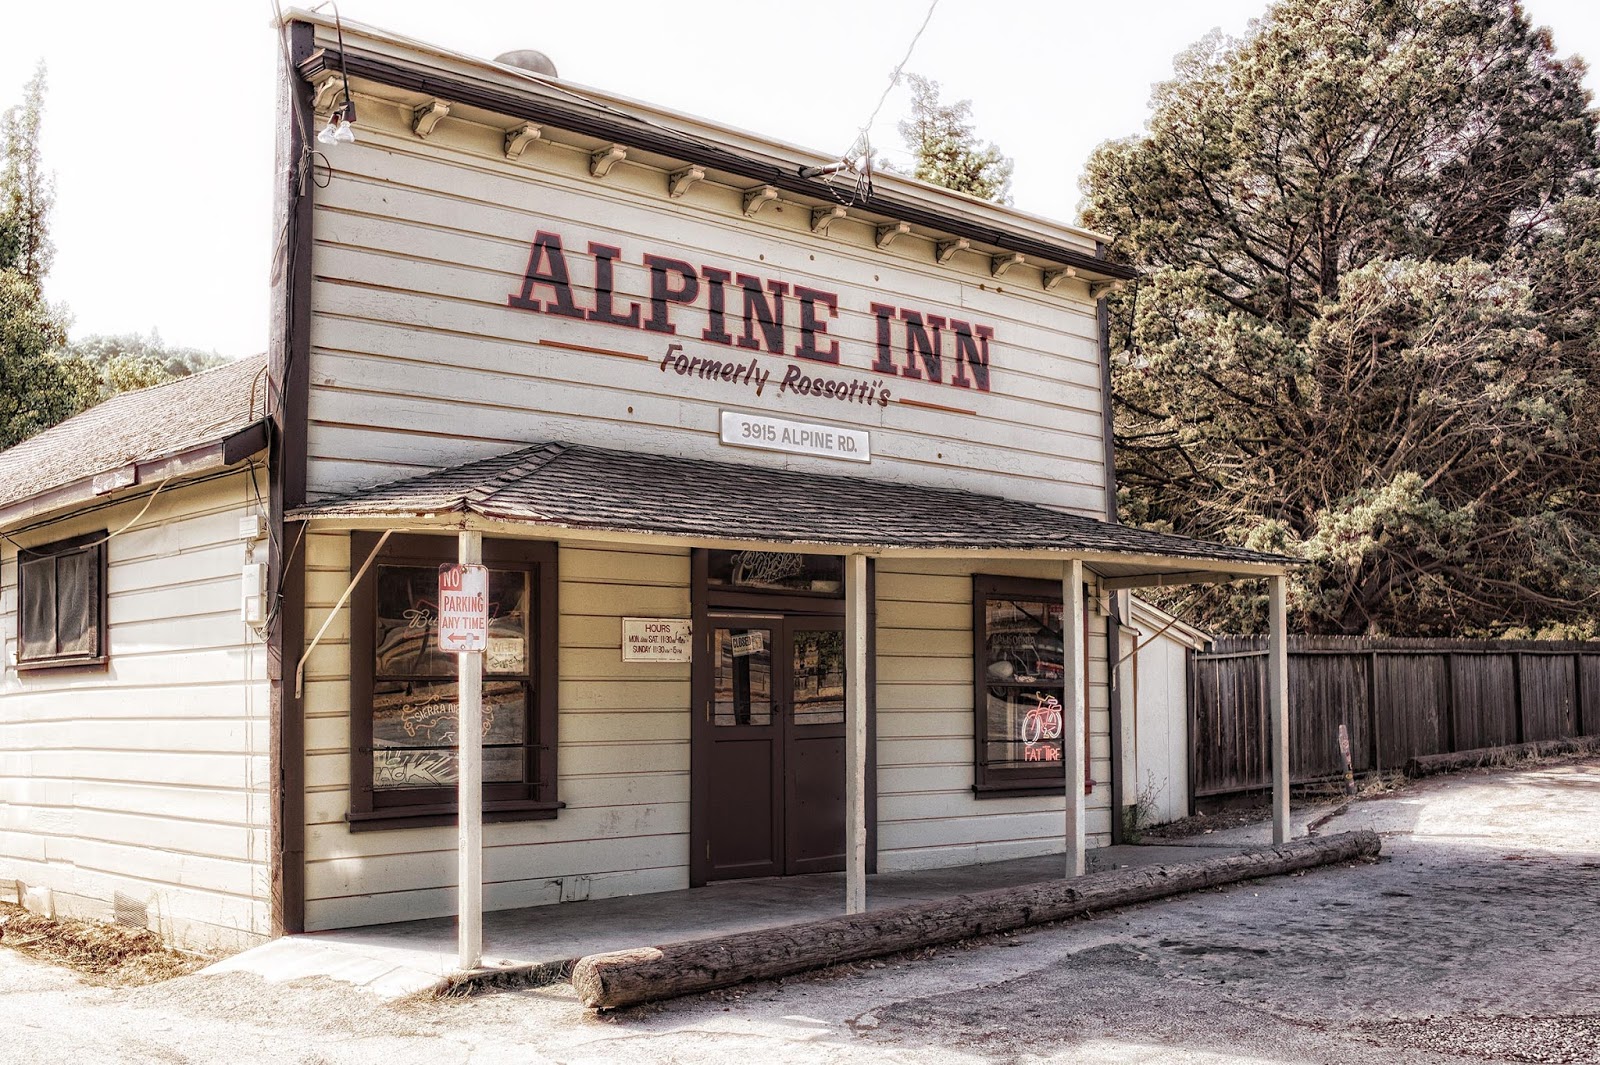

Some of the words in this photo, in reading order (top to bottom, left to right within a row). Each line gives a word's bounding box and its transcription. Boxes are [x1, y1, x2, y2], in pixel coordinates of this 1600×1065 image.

[507, 229, 840, 366] ALPINE
[869, 301, 994, 393] INN
[660, 343, 770, 397] Formerly
[780, 364, 892, 407] Rossotti's
[741, 421, 777, 441] 3915
[781, 427, 833, 450] ALPINE
[837, 433, 858, 453] RD.
[443, 568, 460, 588] NO
[444, 595, 484, 613] PARKING
[442, 617, 460, 629] ANY
[462, 617, 485, 630] TIME
[645, 624, 671, 633] HOURS
[632, 645, 652, 654] SUNDAY
[733, 635, 751, 648] CLOSED
[414, 704, 446, 722] SIERRA
[1025, 745, 1042, 761] FAT
[1042, 745, 1061, 761] TIRE
